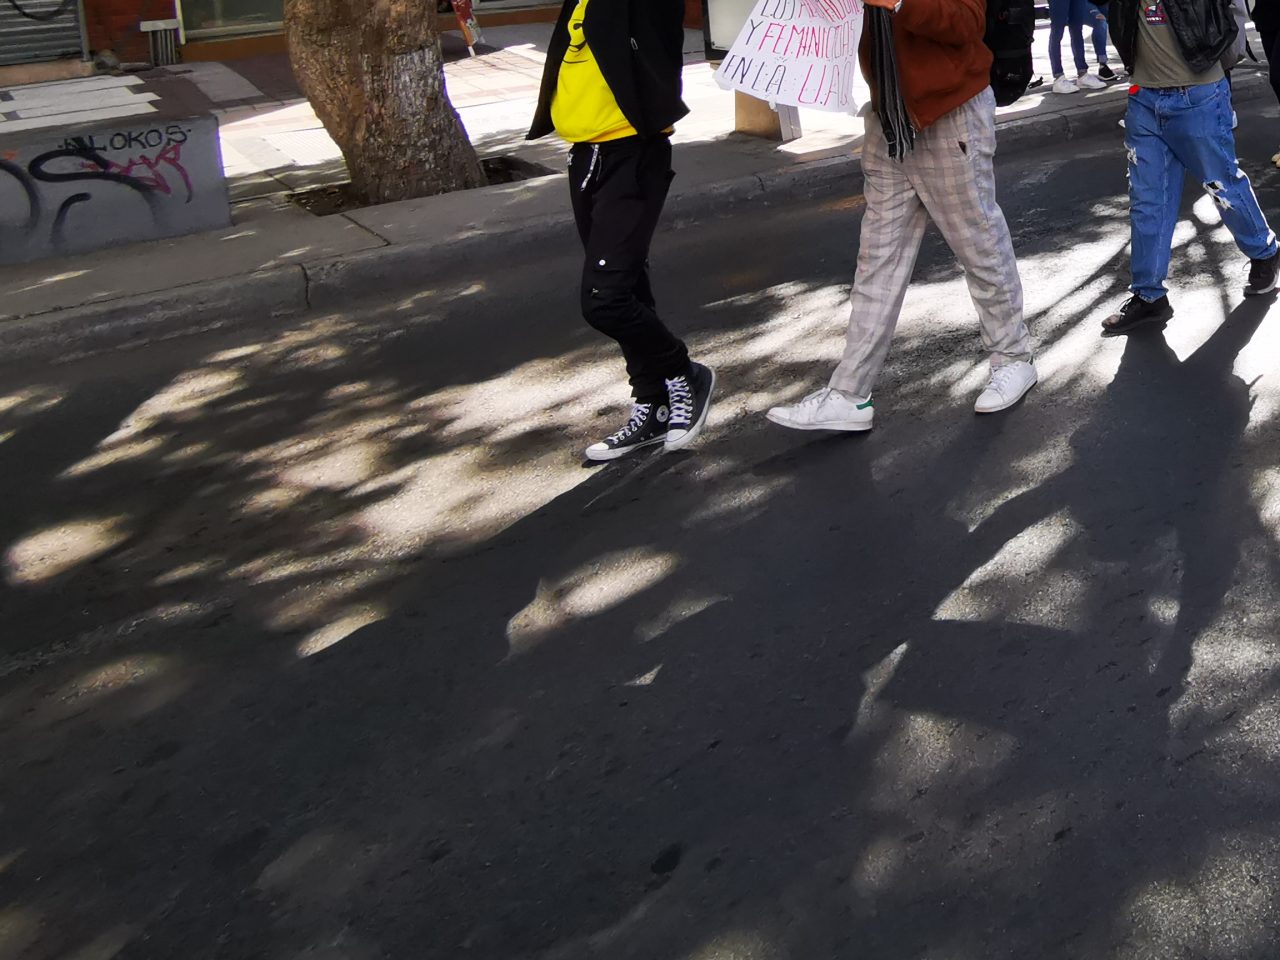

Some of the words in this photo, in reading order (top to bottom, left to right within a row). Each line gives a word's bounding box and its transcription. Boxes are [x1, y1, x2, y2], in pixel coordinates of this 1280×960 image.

[749, 18, 764, 46] Y
[723, 54, 751, 85] EN
[751, 61, 787, 97] LA
